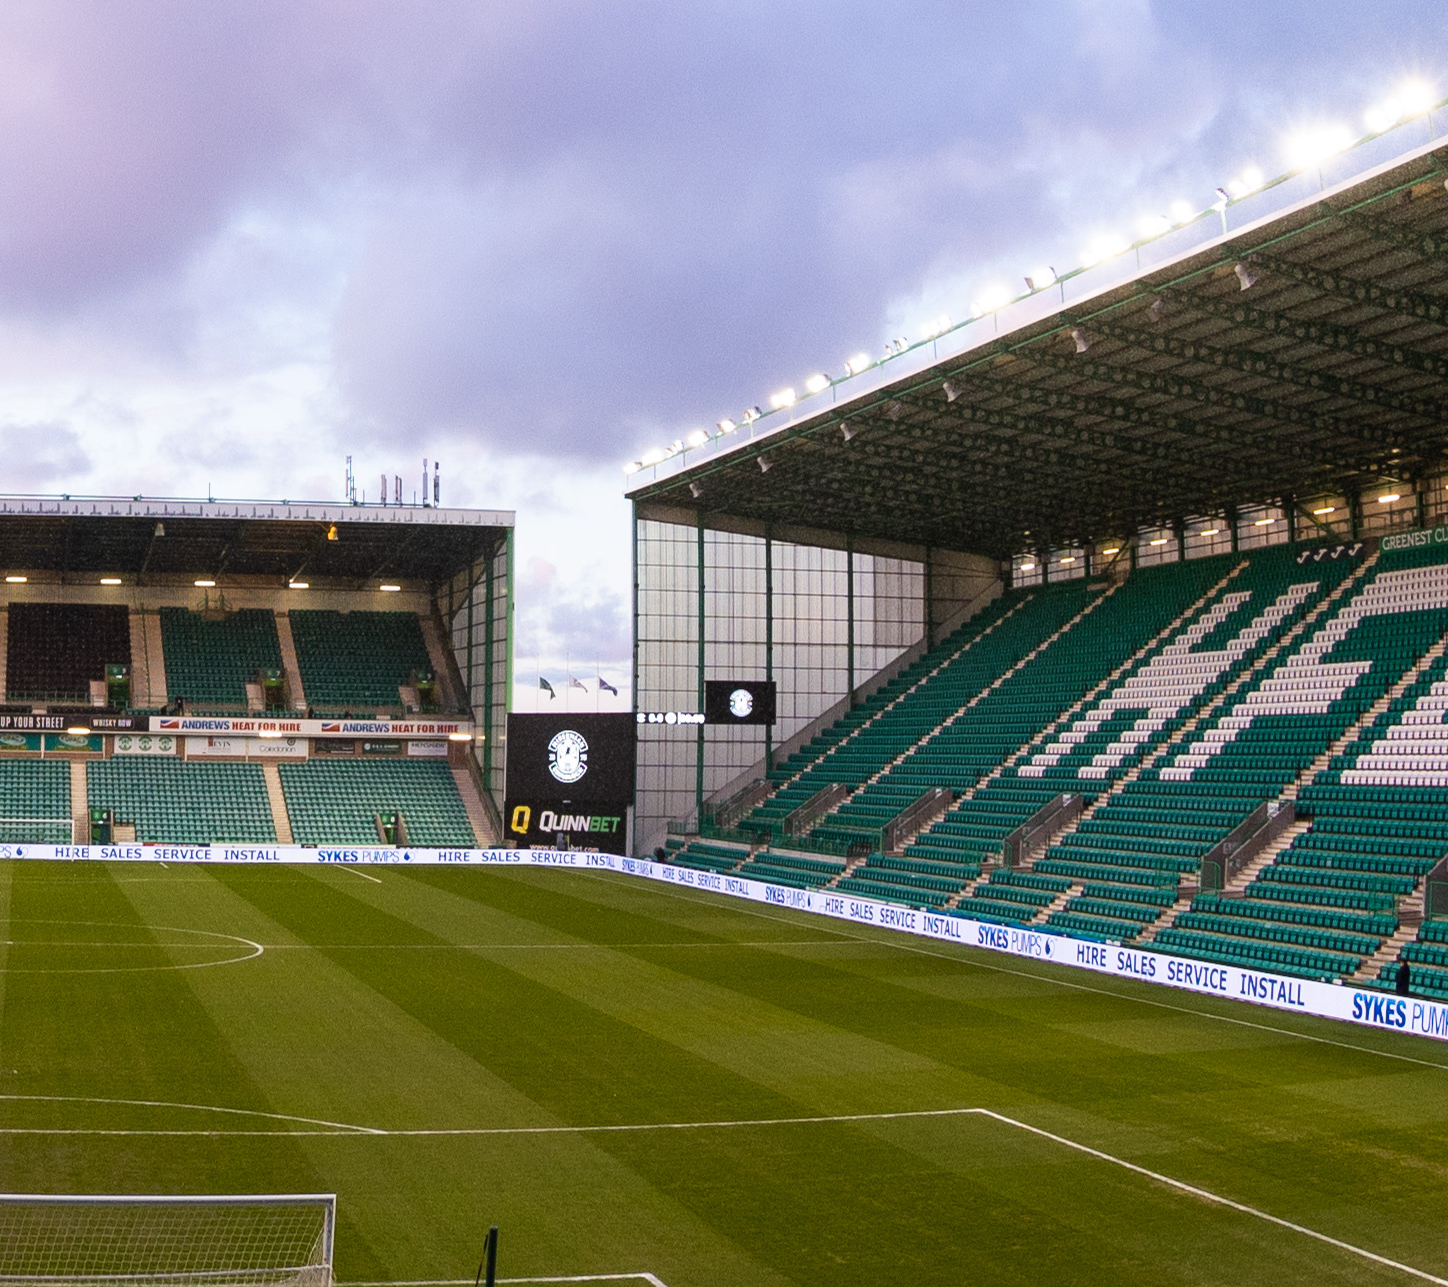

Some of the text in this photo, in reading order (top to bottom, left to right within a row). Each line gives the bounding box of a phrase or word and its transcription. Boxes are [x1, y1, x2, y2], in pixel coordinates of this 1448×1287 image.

[1382, 530, 1432, 551] GREENEST
[0, 716, 12, 727] UP
[13, 716, 34, 728] YOUR
[36, 717, 64, 728] STREET
[182, 720, 301, 732] ANDREWS HEAT FOR HIRE
[511, 805, 621, 834] Q QUINNBET
[977, 924, 1304, 1007] SYKES PUMPS HIRE SALES SERVICE INSTALL
[1352, 992, 1406, 1028] SYKES
